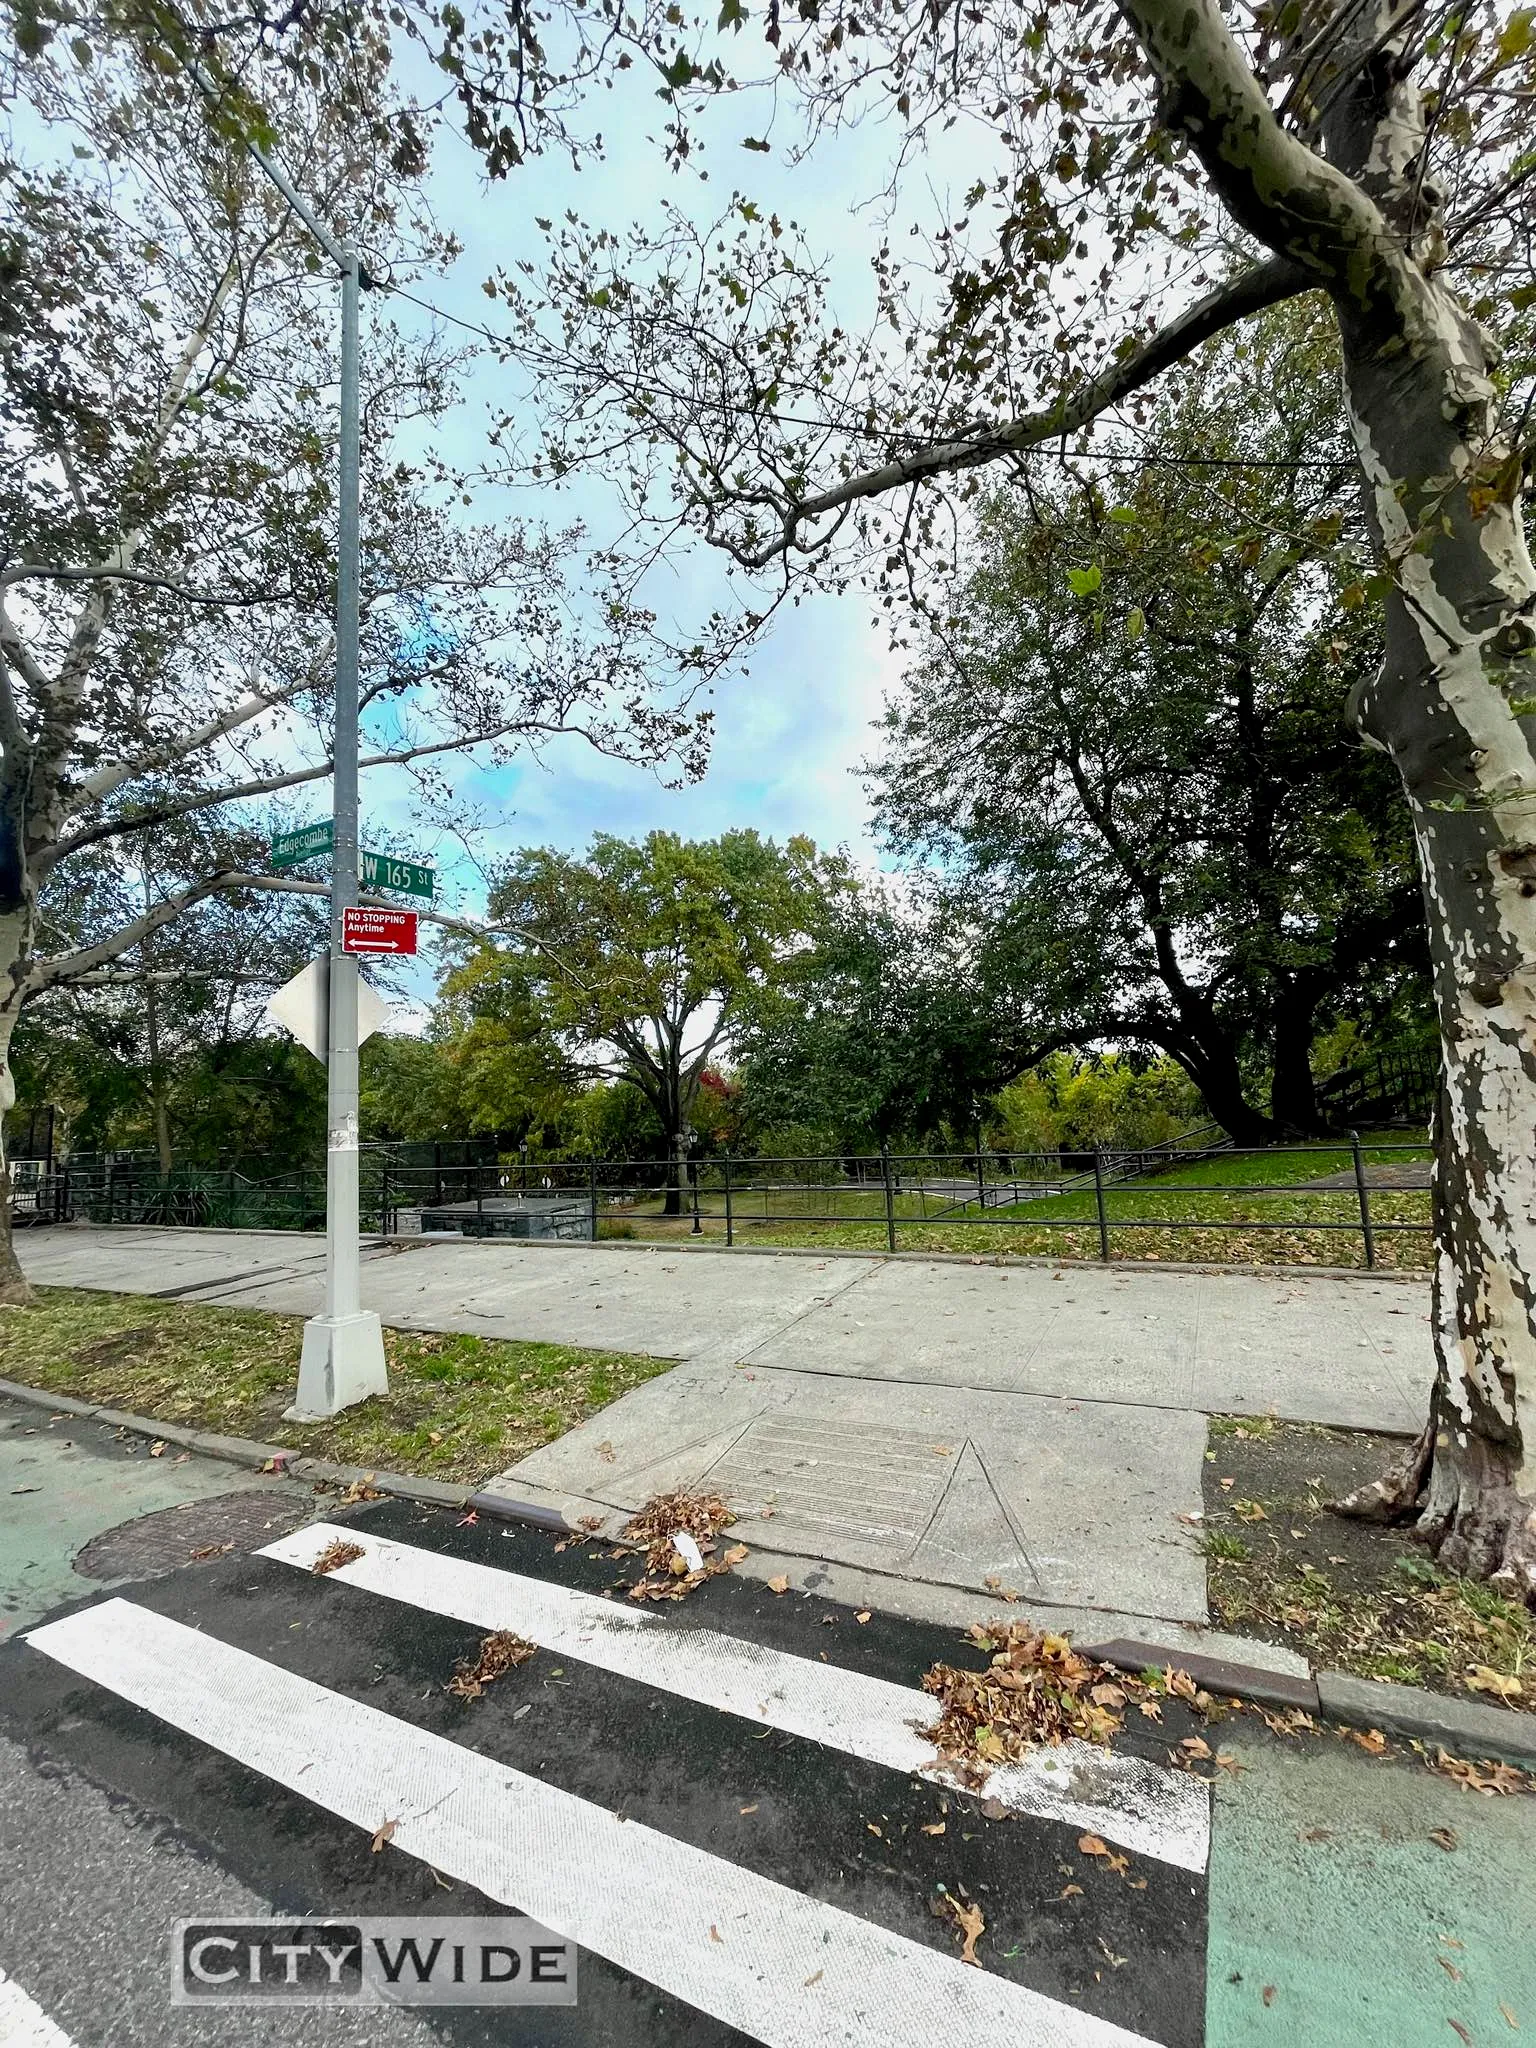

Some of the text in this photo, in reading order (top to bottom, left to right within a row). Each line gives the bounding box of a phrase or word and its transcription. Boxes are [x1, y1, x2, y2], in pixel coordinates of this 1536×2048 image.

[279, 827, 328, 855] Edgecombe
[364, 855, 429, 888] W 165 St
[347, 912, 406, 925] NO STOPPING
[347, 922, 385, 933] Anytime
